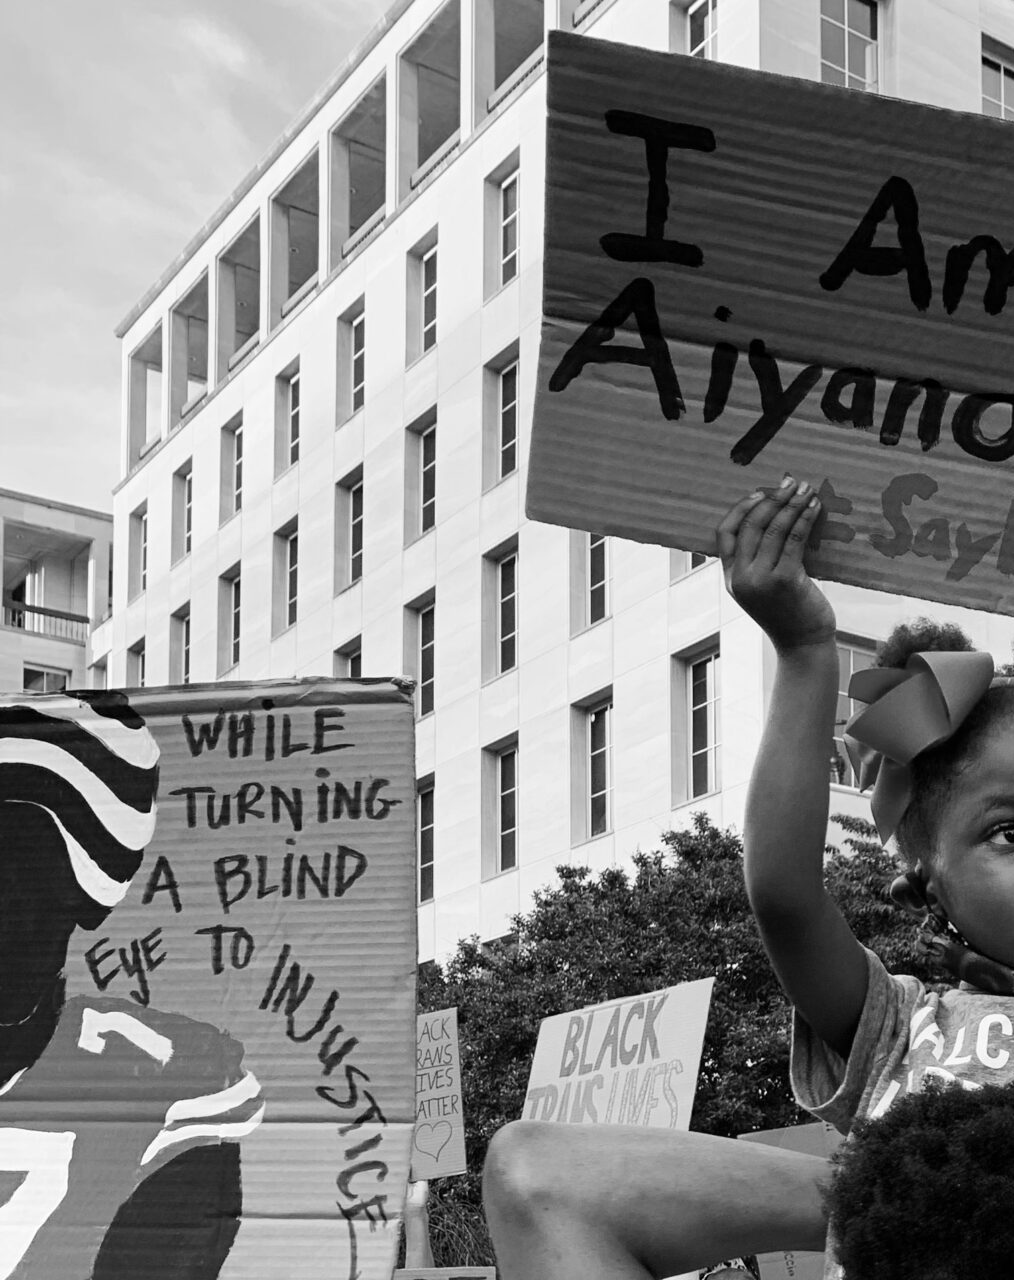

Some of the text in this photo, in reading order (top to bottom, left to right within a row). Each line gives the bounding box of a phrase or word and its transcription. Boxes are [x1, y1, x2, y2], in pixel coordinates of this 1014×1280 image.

[600, 109, 716, 267] I
[142, 856, 182, 913] A
[417, 1016, 450, 1044] ACK
[559, 993, 669, 1078] BLACK
[417, 1044, 453, 1068] RANS
[194, 924, 256, 975] TO
[259, 944, 390, 1236] INJUSTICE
[416, 1067, 454, 1094] IVES
[418, 1094, 459, 1119] ATTER
